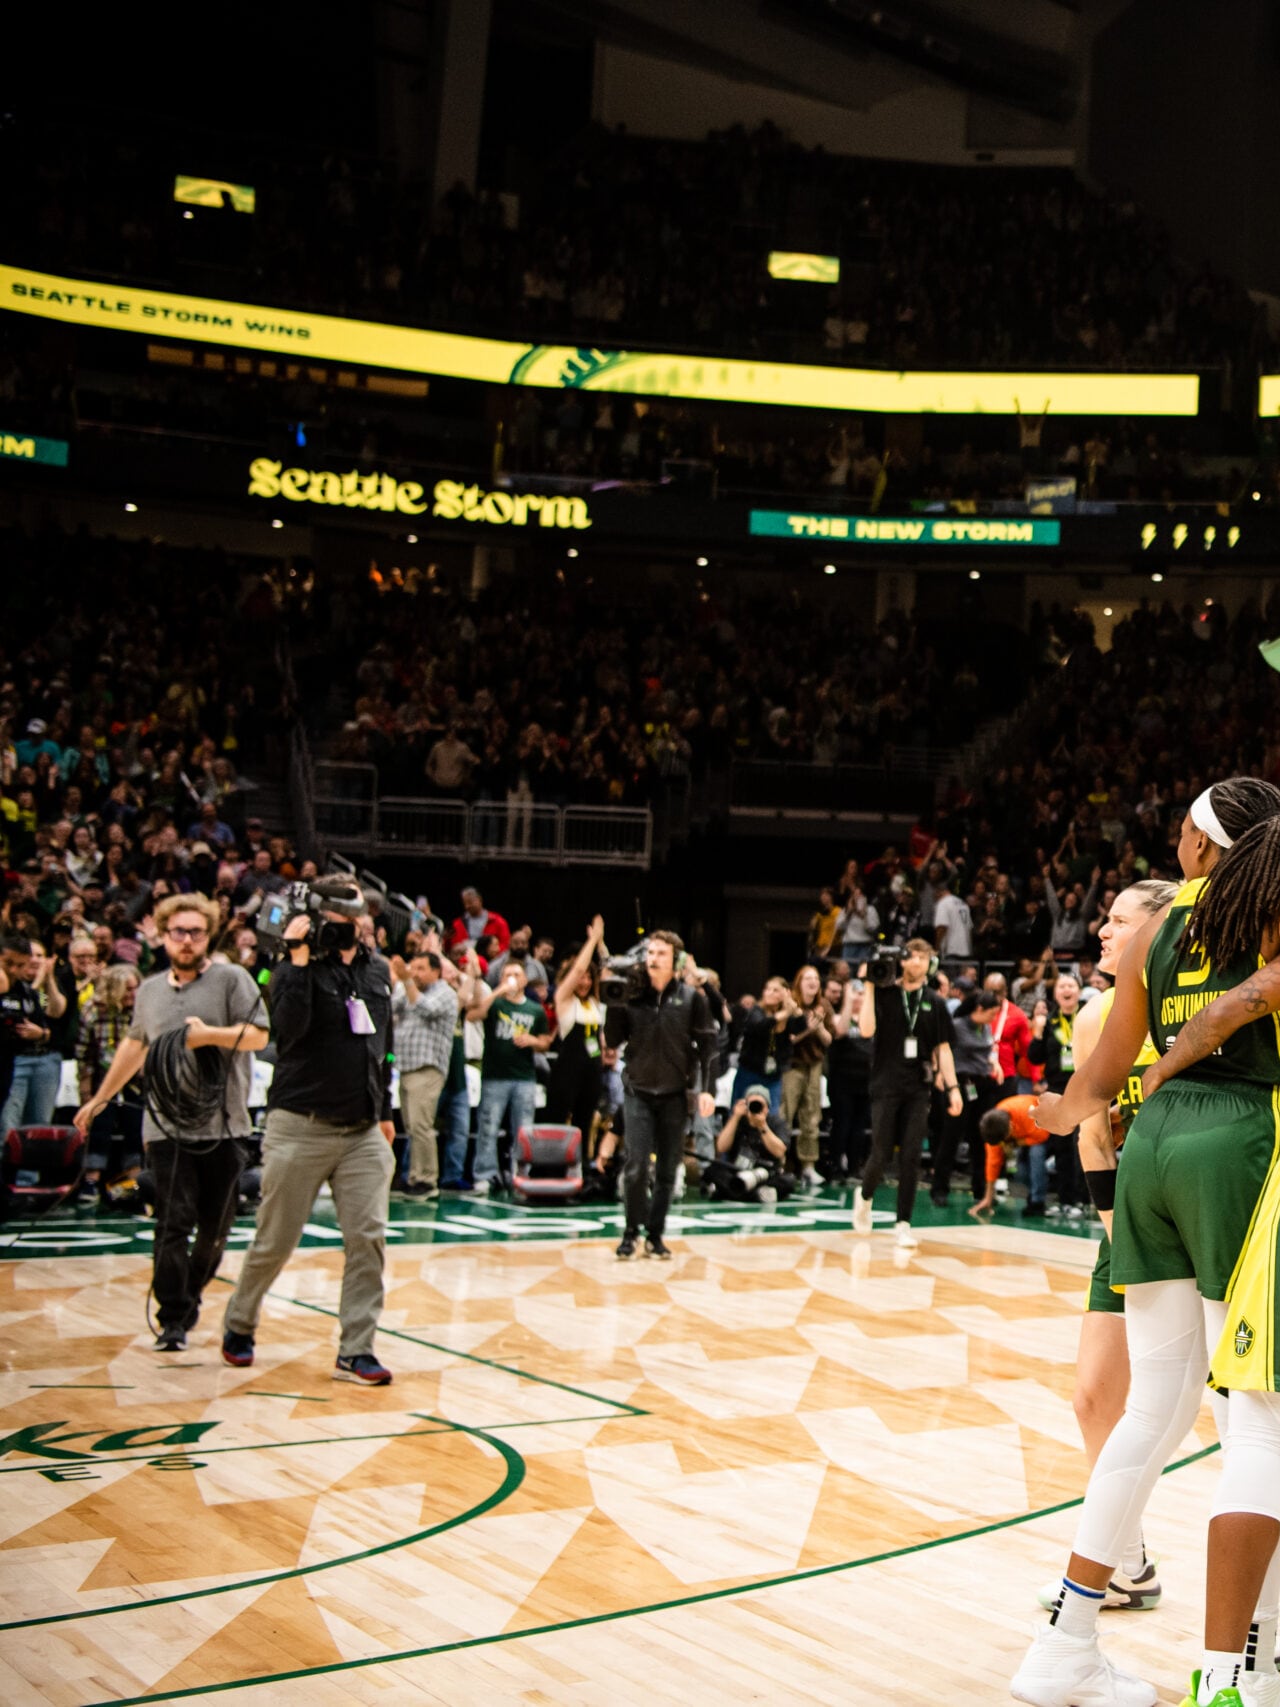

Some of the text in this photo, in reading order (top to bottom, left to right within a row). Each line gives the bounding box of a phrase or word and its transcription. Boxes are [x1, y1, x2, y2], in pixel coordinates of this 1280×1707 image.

[11, 282, 311, 340] SEATTLE STORM WINS
[248, 457, 592, 529] Seattle Storm
[788, 515, 1033, 541] THE NEW STORM
